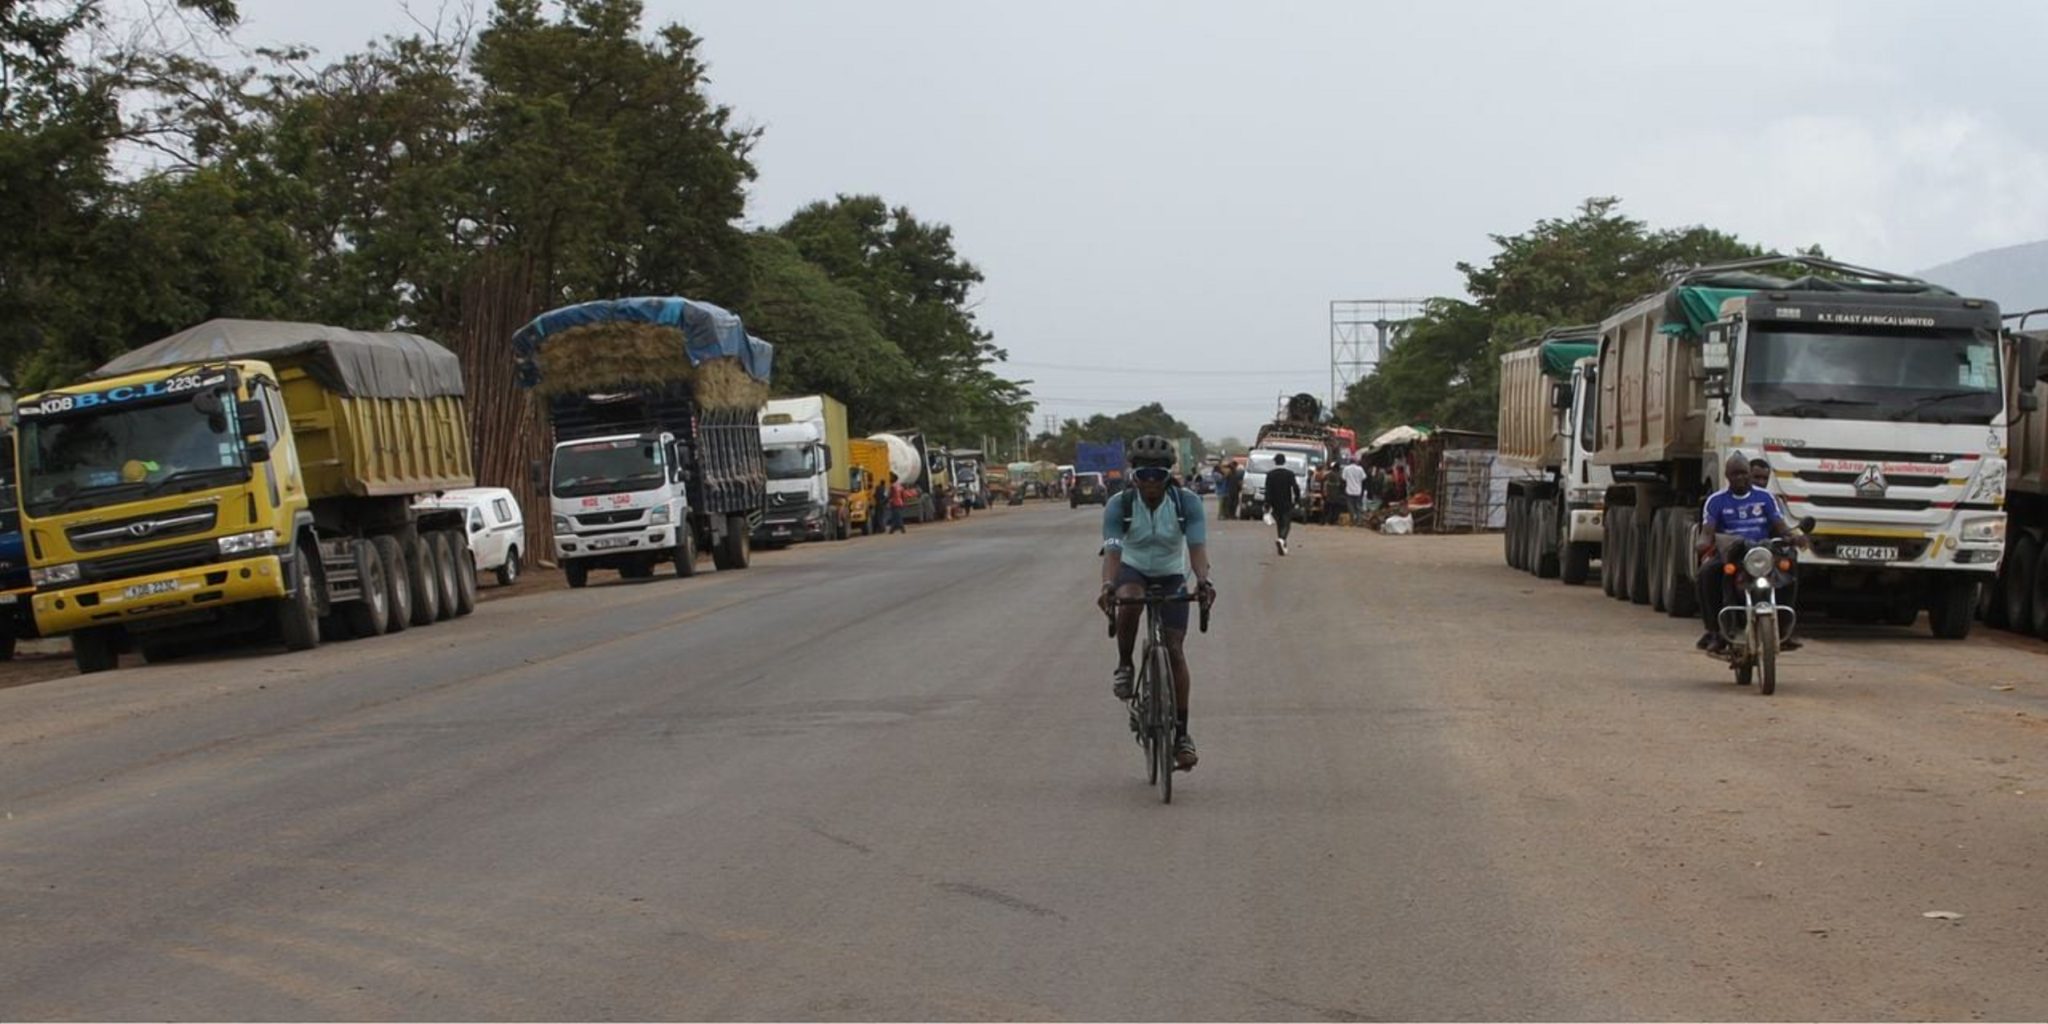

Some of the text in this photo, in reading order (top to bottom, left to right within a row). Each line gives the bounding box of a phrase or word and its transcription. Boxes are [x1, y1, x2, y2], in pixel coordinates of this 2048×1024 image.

[1898, 317, 1935, 327] LIMITED
[40, 397, 73, 415] KDB
[165, 375, 201, 393] 223C
[1838, 547, 1860, 559] KCU
